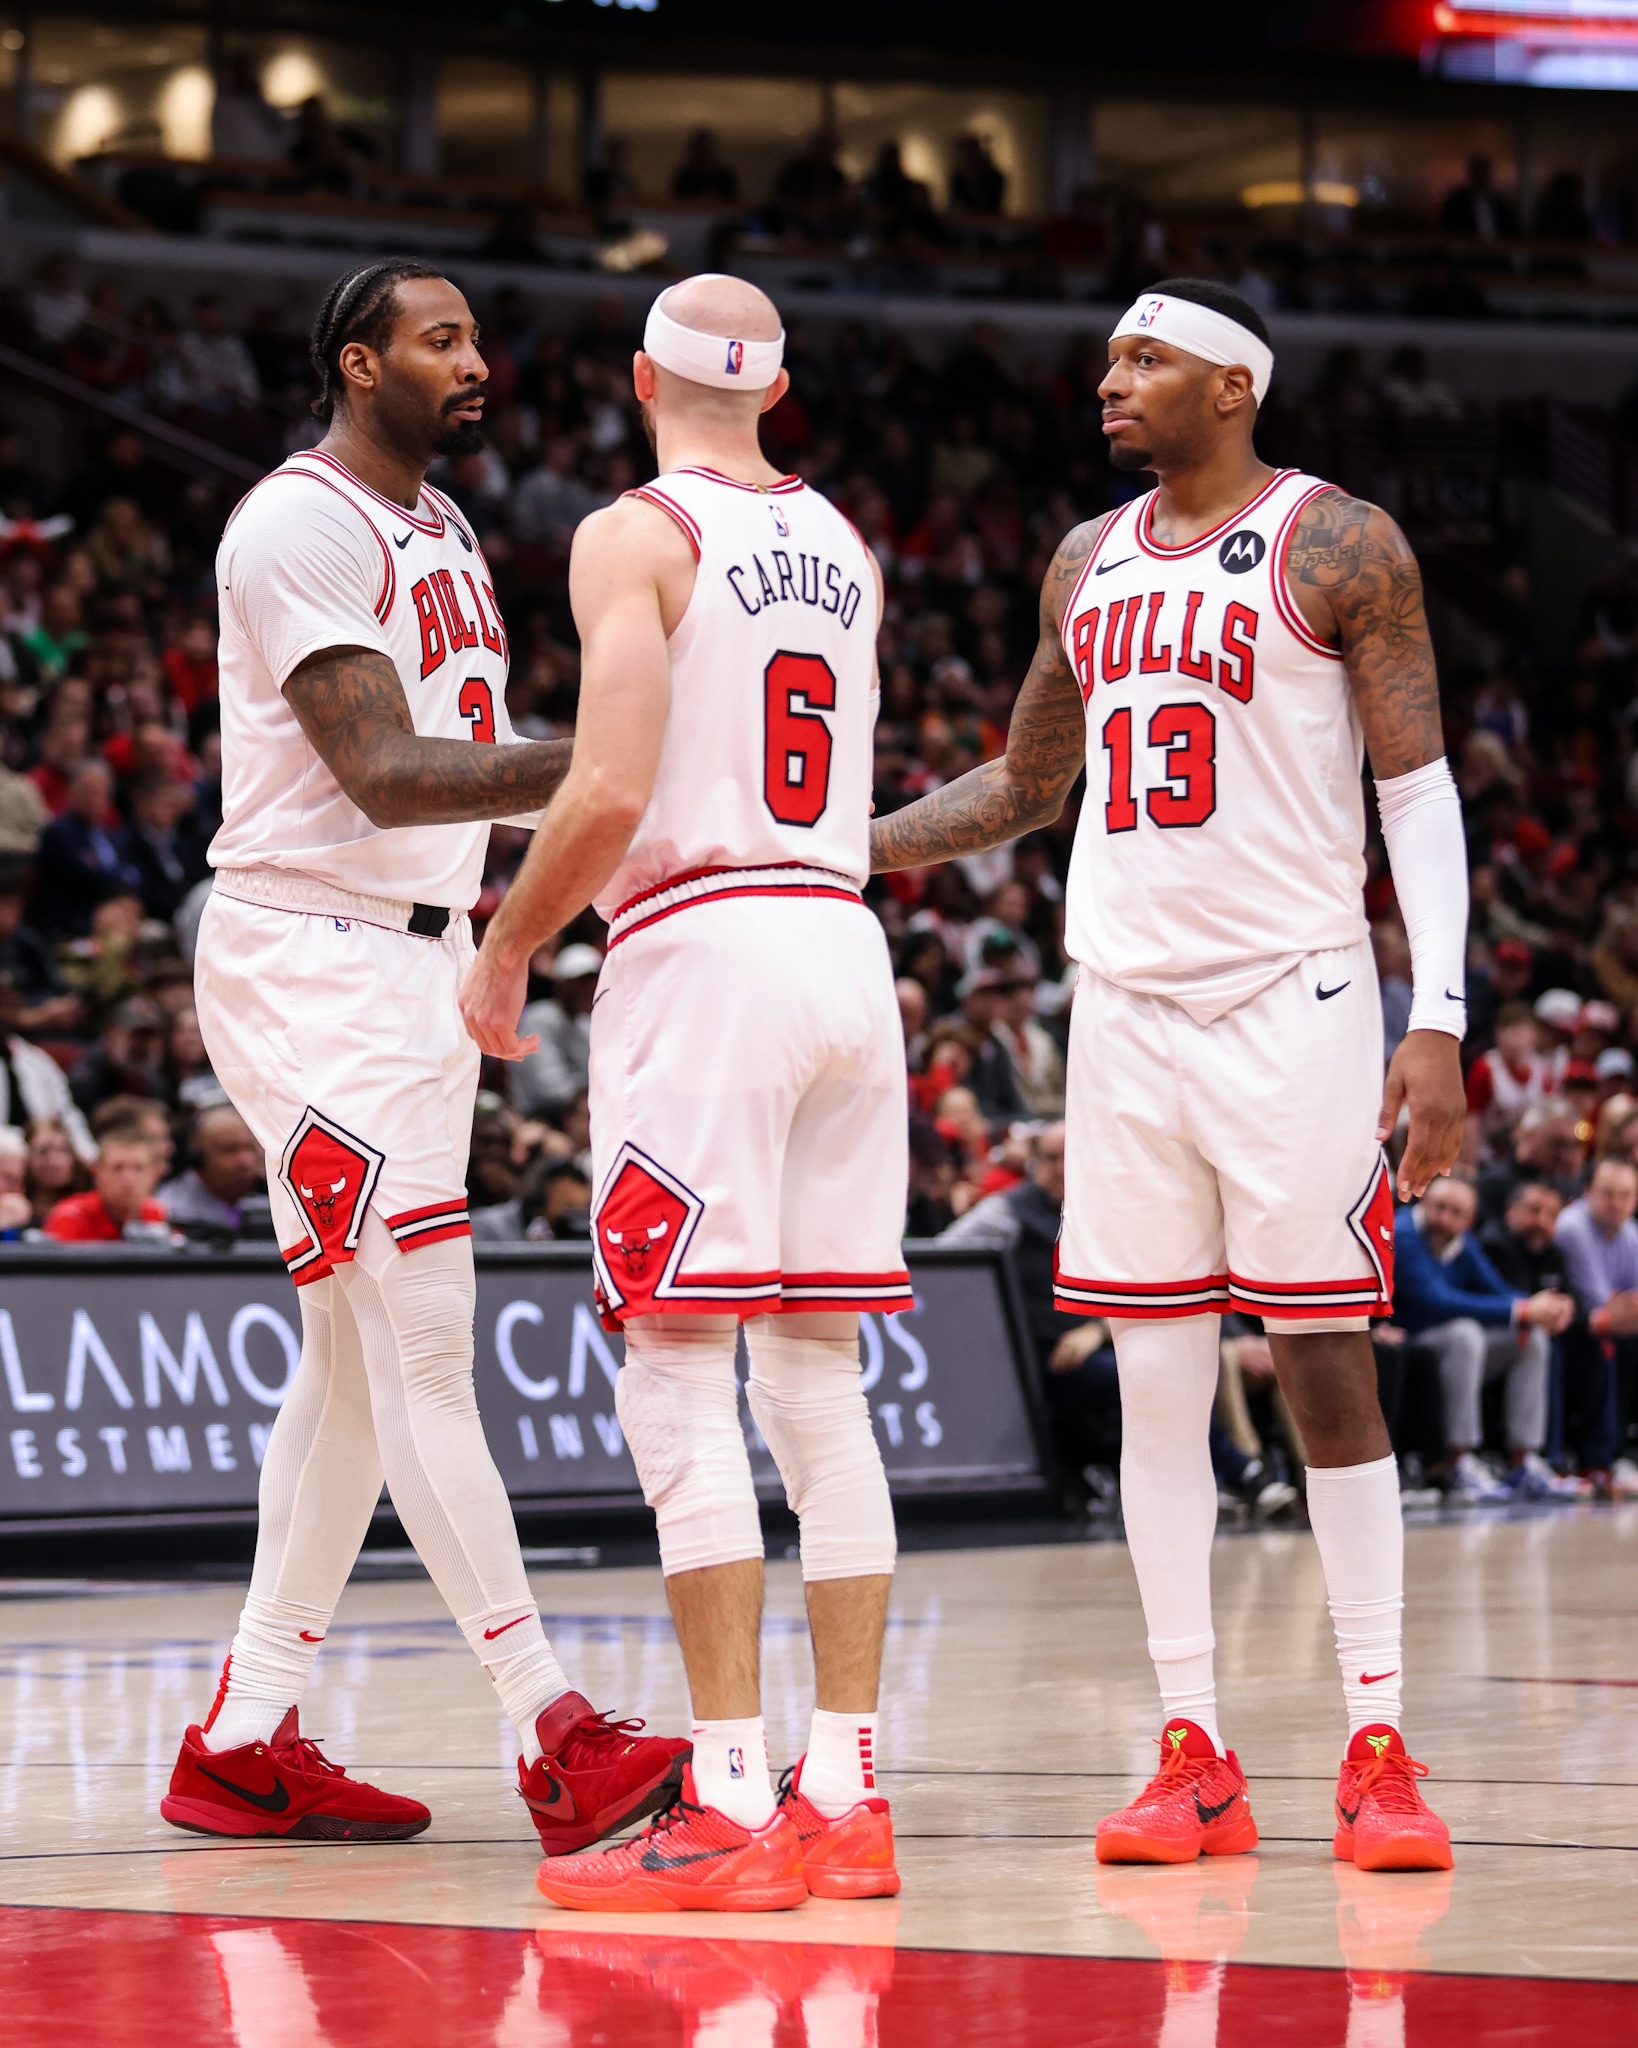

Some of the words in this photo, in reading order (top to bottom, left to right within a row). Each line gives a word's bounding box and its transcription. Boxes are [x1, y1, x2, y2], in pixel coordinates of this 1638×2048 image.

[410, 568, 509, 682] BULLS
[726, 550, 861, 630] CARUSO
[1072, 590, 1259, 708] BULLS
[458, 677, 497, 745] 3
[763, 649, 837, 829] 6
[1102, 702, 1217, 835] 13
